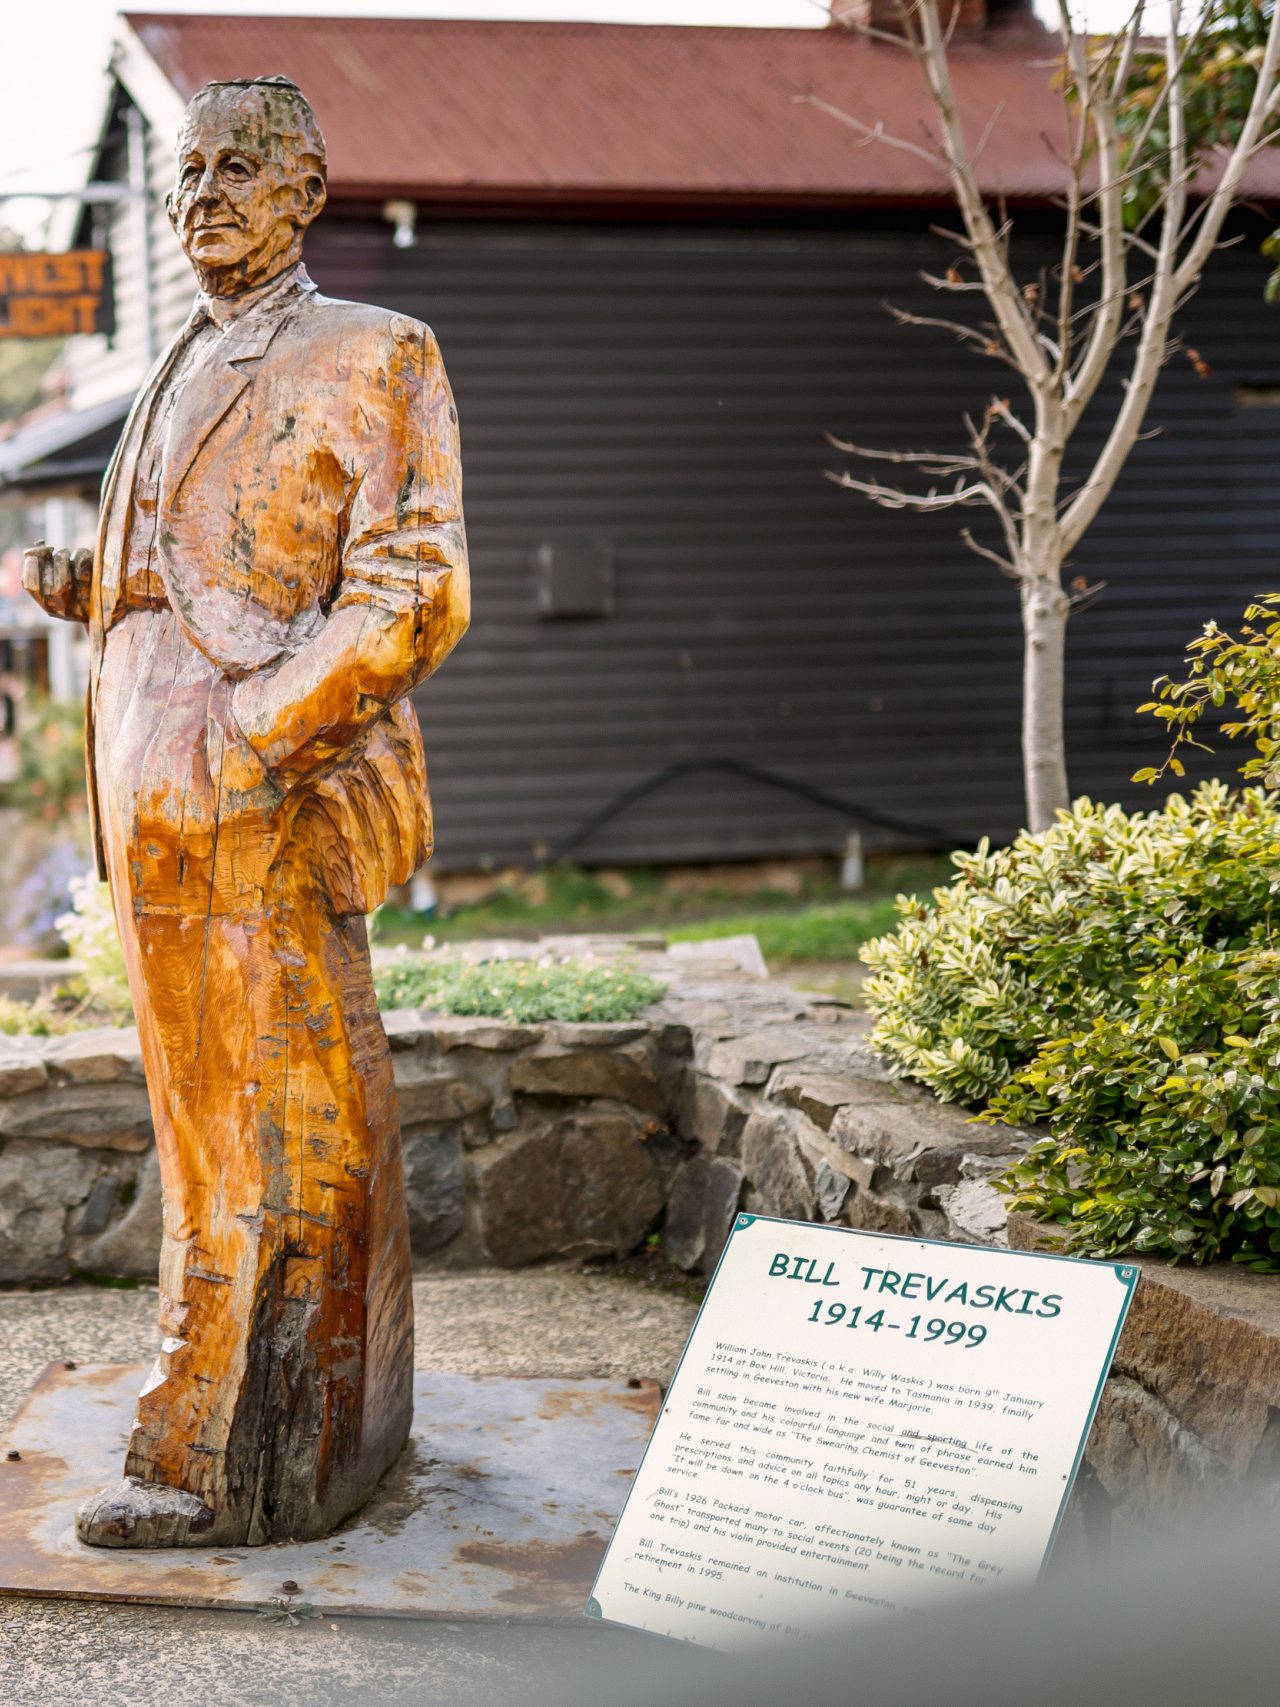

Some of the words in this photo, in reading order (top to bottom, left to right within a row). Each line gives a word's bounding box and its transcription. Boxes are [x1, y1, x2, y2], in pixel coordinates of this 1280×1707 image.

[768, 1253, 840, 1286] BILL
[860, 1266, 1063, 1318] TREVASKIS
[807, 1299, 988, 1349] 1914-1999
[705, 1366, 739, 1379] settling
[741, 1371, 751, 1380] in
[752, 1373, 800, 1389] Geeveston
[802, 1384, 823, 1393] with
[825, 1386, 840, 1397] his
[842, 1391, 862, 1401] new
[864, 1395, 885, 1405] wife
[710, 1353, 734, 1364] 1914
[749, 1360, 767, 1370] Box
[840, 1376, 854, 1386] He
[856, 1381, 888, 1393] moved
[891, 1386, 901, 1395] to
[906, 1388, 951, 1404] Tasmania
[954, 1397, 964, 1406] in
[1002, 1405, 1035, 1421] finally
[715, 1341, 747, 1354] William
[749, 1348, 772, 1359] John
[776, 1352, 819, 1368] Trevaskis
[821, 1360, 827, 1370] (
[862, 1368, 887, 1381] Willy
[890, 1372, 925, 1386] Waskis
[927, 1379, 933, 1389] )
[936, 1383, 955, 1392] was
[958, 1384, 982, 1396] born
[1002, 1393, 1045, 1409] January
[688, 1410, 711, 1422] fame
[715, 1416, 731, 1426] far
[733, 1422, 751, 1431] and
[752, 1425, 773, 1435] wide
[775, 1430, 787, 1438] as
[815, 1437, 859, 1454] Swearing
[861, 1446, 901, 1461] Chemist
[904, 1455, 917, 1464] of
[692, 1400, 738, 1416] community
[740, 1410, 758, 1419] and
[761, 1412, 776, 1422] his
[779, 1418, 822, 1431] colourful
[825, 1425, 866, 1441] language
[871, 1436, 890, 1445] and
[894, 1440, 915, 1450] turn
[920, 1445, 933, 1454] of
[936, 1448, 972, 1462] phrase
[977, 1457, 1014, 1470] earned
[1018, 1463, 1038, 1475] him
[696, 1387, 712, 1397] Bill
[716, 1393, 737, 1402] soon
[743, 1396, 777, 1410] became
[784, 1404, 822, 1419] involved
[827, 1413, 836, 1422] in
[844, 1416, 860, 1426] the
[866, 1422, 895, 1433] social
[901, 1428, 920, 1438] and
[927, 1432, 968, 1450] sporting
[975, 1442, 993, 1452] life
[1000, 1447, 1014, 1456] of
[1022, 1451, 1039, 1462] the
[673, 1444, 732, 1462] prescriptions
[737, 1458, 756, 1467] and
[757, 1462, 787, 1474] advice
[790, 1469, 802, 1477] on
[805, 1471, 818, 1480] all
[822, 1474, 850, 1487] topics
[853, 1483, 872, 1493] any
[905, 1493, 932, 1505] night
[935, 1500, 948, 1508] or
[985, 1509, 1003, 1520] His
[679, 1432, 692, 1442] He
[700, 1438, 732, 1450] served
[739, 1445, 757, 1455] this
[765, 1452, 815, 1469] community
[823, 1462, 869, 1480] faithfully
[878, 1473, 895, 1484] for
[903, 1478, 917, 1489] 51
[970, 1493, 1023, 1513] dispensing
[688, 1459, 703, 1468] will
[705, 1461, 718, 1471] be
[720, 1465, 744, 1477] down
[748, 1473, 760, 1481] on
[763, 1475, 779, 1485] the
[782, 1478, 790, 1487] 4
[792, 1481, 825, 1495] o'clock
[856, 1496, 875, 1506] was
[877, 1501, 928, 1518] guarantee
[931, 1512, 945, 1521] of
[947, 1516, 973, 1528] same
[977, 1521, 997, 1533] day
[633, 1552, 683, 1570] retirement
[686, 1564, 696, 1573] in
[649, 1513, 666, 1522] one
[669, 1516, 690, 1530] trip)
[693, 1523, 711, 1533] and
[712, 1526, 727, 1537] his
[730, 1532, 754, 1544] violin
[755, 1538, 798, 1554] provided
[658, 1486, 679, 1499] Bill's
[684, 1492, 708, 1505] 1926
[712, 1498, 751, 1515] Packard
[754, 1510, 784, 1522] motor
[814, 1523, 885, 1547] affectionately
[890, 1539, 921, 1555] known
[927, 1550, 939, 1559] as
[978, 1560, 1003, 1574] Grey
[687, 1507, 742, 1527] transported
[744, 1522, 769, 1534] many
[773, 1527, 784, 1537] to
[787, 1532, 815, 1544] social
[818, 1539, 851, 1553] events
[854, 1546, 872, 1557] (20
[876, 1550, 903, 1566] being
[908, 1559, 925, 1570] the
[929, 1565, 965, 1579] record
[623, 1581, 640, 1594] The
[642, 1587, 663, 1602] King
[664, 1593, 686, 1607] Billy
[686, 1600, 707, 1612] pine
[709, 1607, 767, 1629] woodcarving
[770, 1623, 782, 1631] of
[638, 1537, 654, 1549] Bill
[660, 1542, 703, 1562] Trevaskis
[707, 1557, 752, 1574] remained
[756, 1570, 768, 1578] an
[774, 1571, 823, 1592] institution
[829, 1585, 839, 1596] in
[844, 1590, 896, 1609] Geeveston
